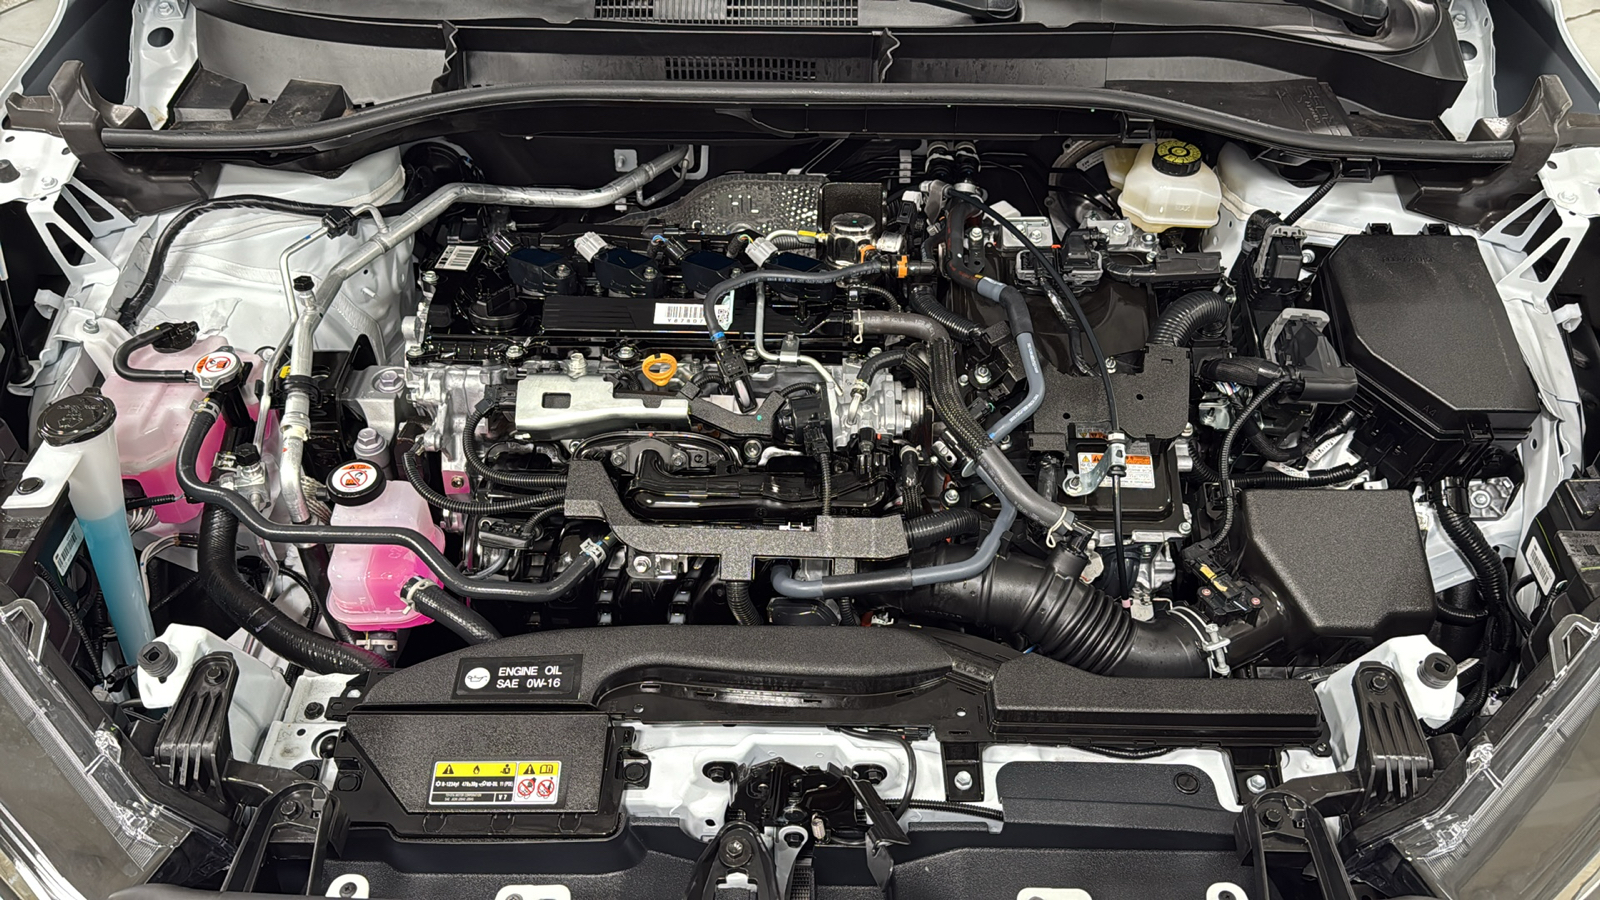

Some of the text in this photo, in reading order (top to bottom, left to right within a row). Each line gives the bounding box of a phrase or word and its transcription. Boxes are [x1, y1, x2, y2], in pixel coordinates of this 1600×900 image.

[498, 665, 563, 676] ENGINE OIL
[496, 677, 561, 688] SAE 0W-16
